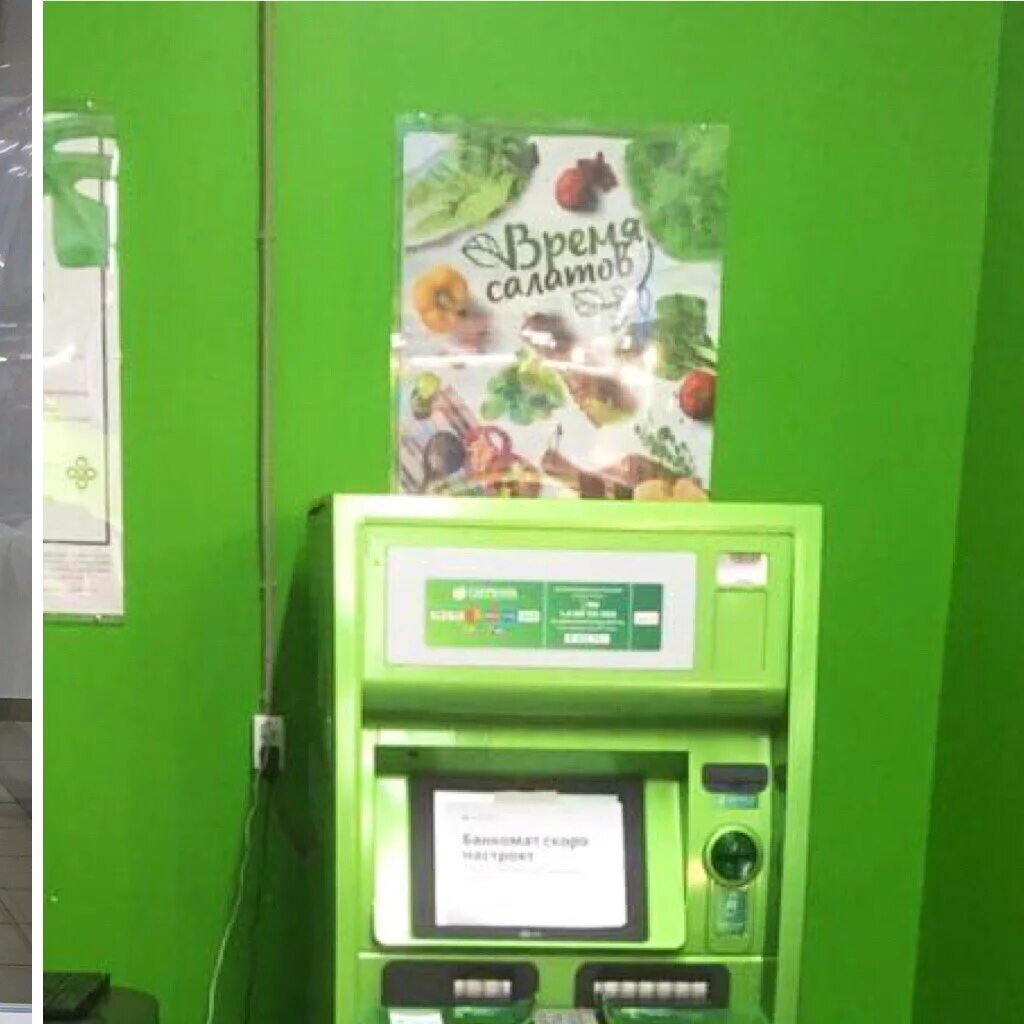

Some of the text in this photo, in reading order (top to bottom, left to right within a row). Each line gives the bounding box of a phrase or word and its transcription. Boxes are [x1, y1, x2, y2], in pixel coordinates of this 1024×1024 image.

[503, 217, 644, 271] Время
[486, 244, 635, 302] салатов
[462, 833, 590, 851] Банкомат скоро
